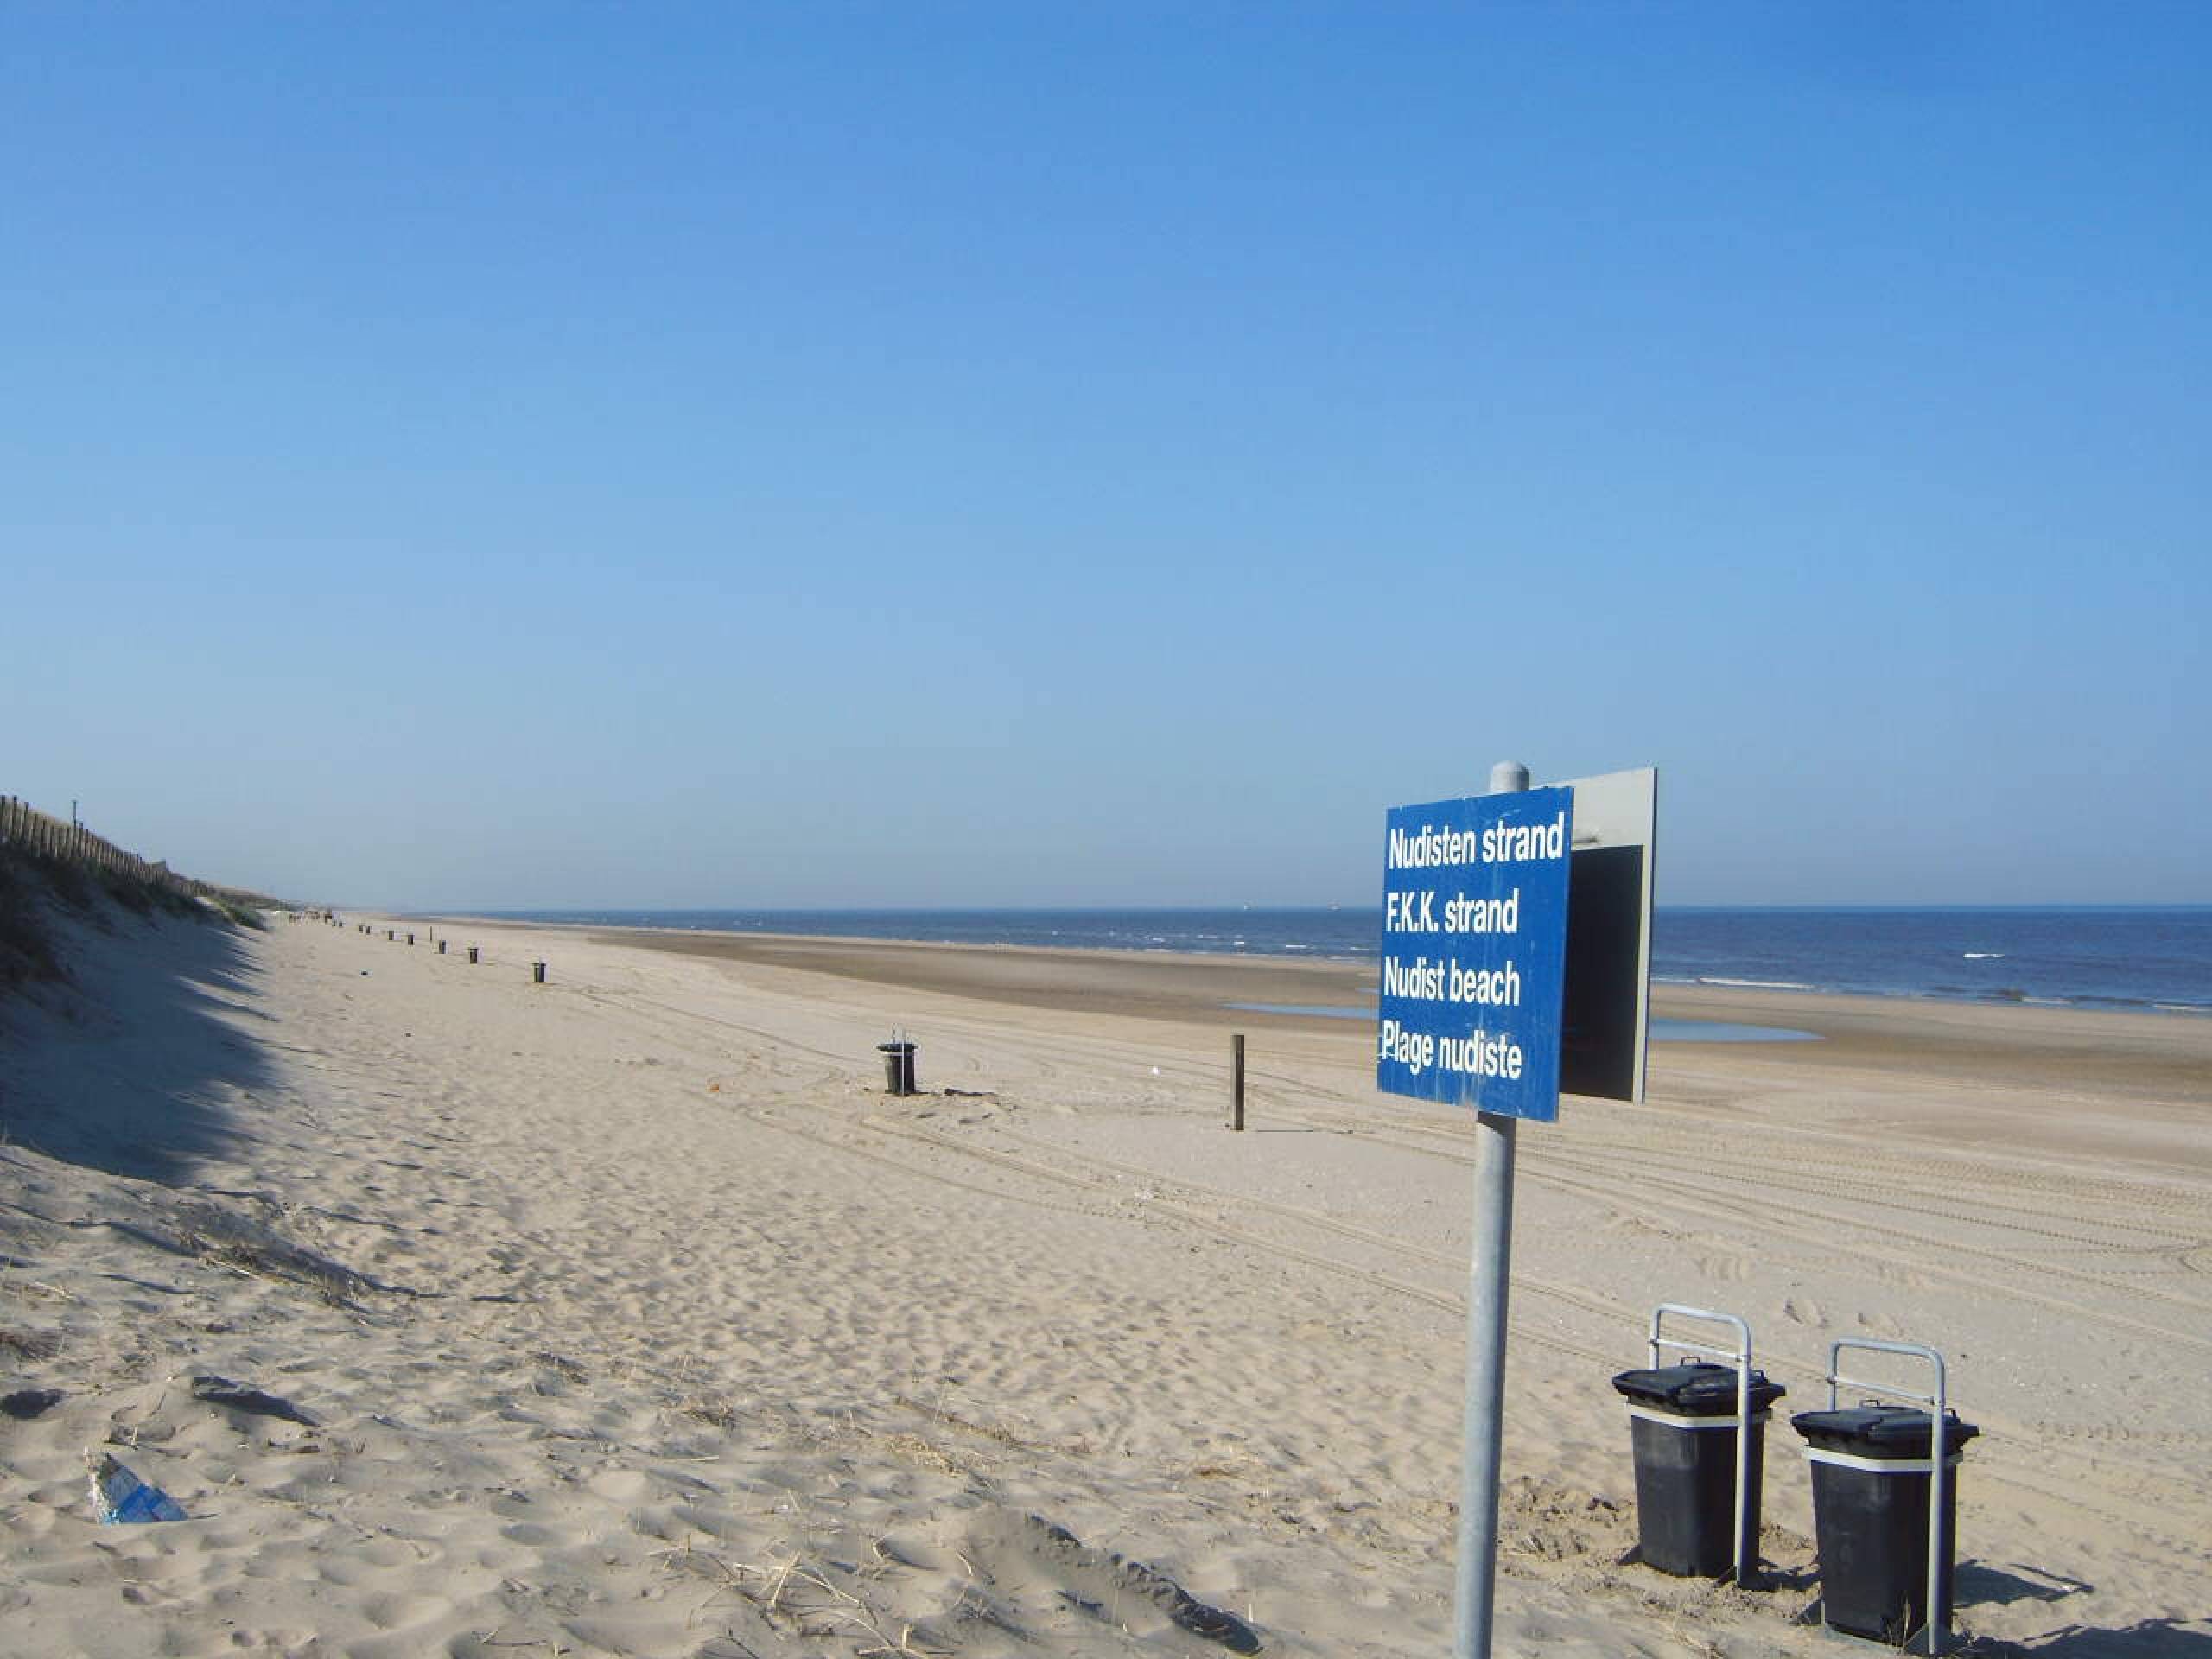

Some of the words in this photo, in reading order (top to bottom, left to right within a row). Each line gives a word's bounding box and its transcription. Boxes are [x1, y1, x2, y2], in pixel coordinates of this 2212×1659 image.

[1389, 825, 1475, 868] Nudisten
[1482, 812, 1564, 862] strand
[1386, 890, 1438, 932] F.K.K.
[1445, 887, 1519, 933] strand
[1383, 956, 1445, 1000] Nudist
[1450, 958, 1520, 1006] beach
[1382, 1020, 1433, 1075] Plage
[1438, 1031, 1522, 1080] nudiste
